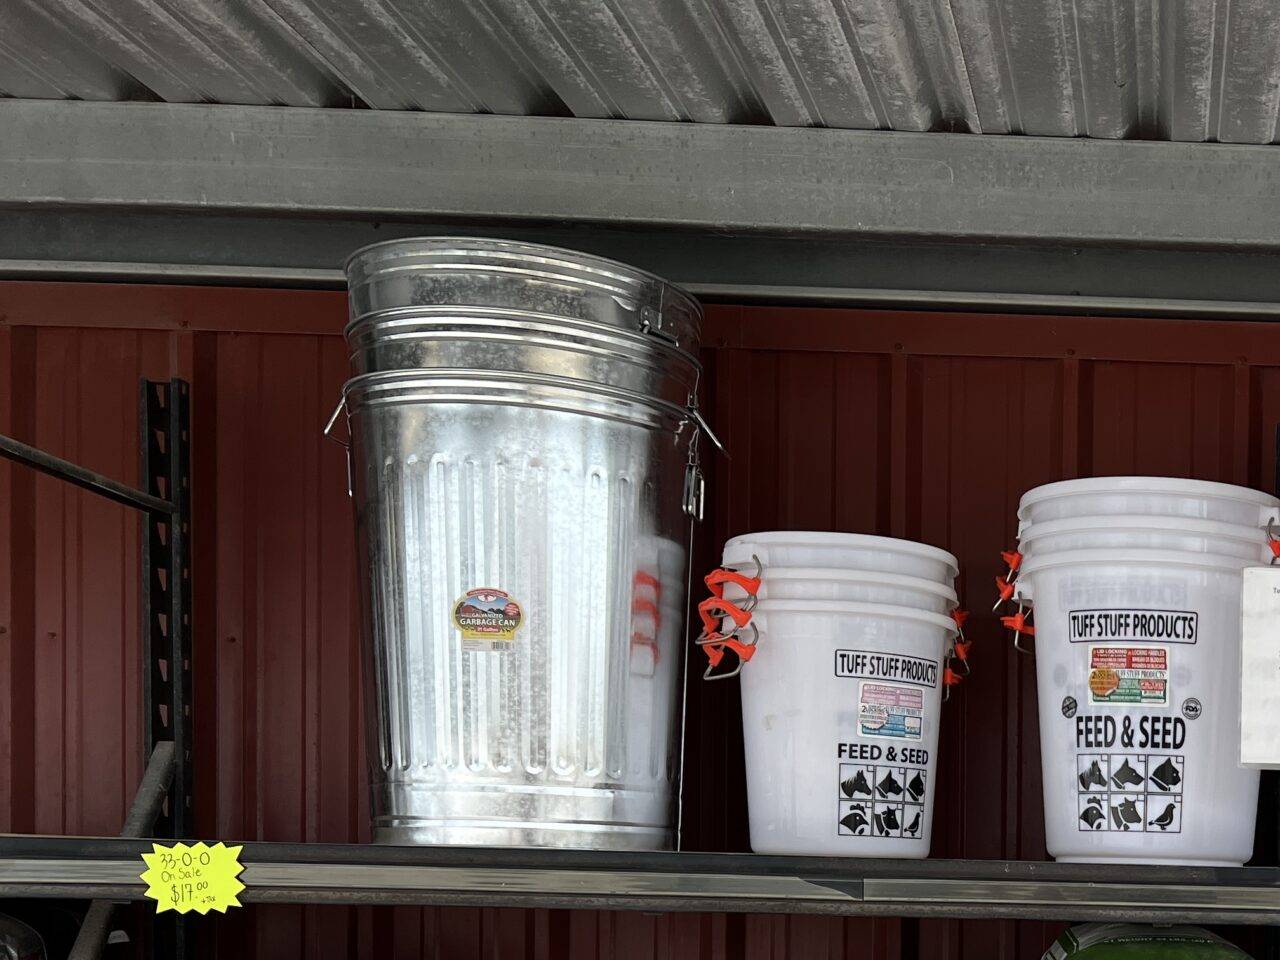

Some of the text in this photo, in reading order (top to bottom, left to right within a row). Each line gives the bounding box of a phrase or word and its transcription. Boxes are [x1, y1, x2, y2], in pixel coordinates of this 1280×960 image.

[1072, 613, 1194, 640] TUFF STUFF PRODUCTS
[839, 653, 937, 684] TUFF STUFF PRODUCTS
[1076, 715, 1186, 749] FEED & SEED
[837, 743, 929, 765] FEED & SEED
[160, 852, 210, 869] 33-0-0
[161, 867, 202, 883] On Sale
